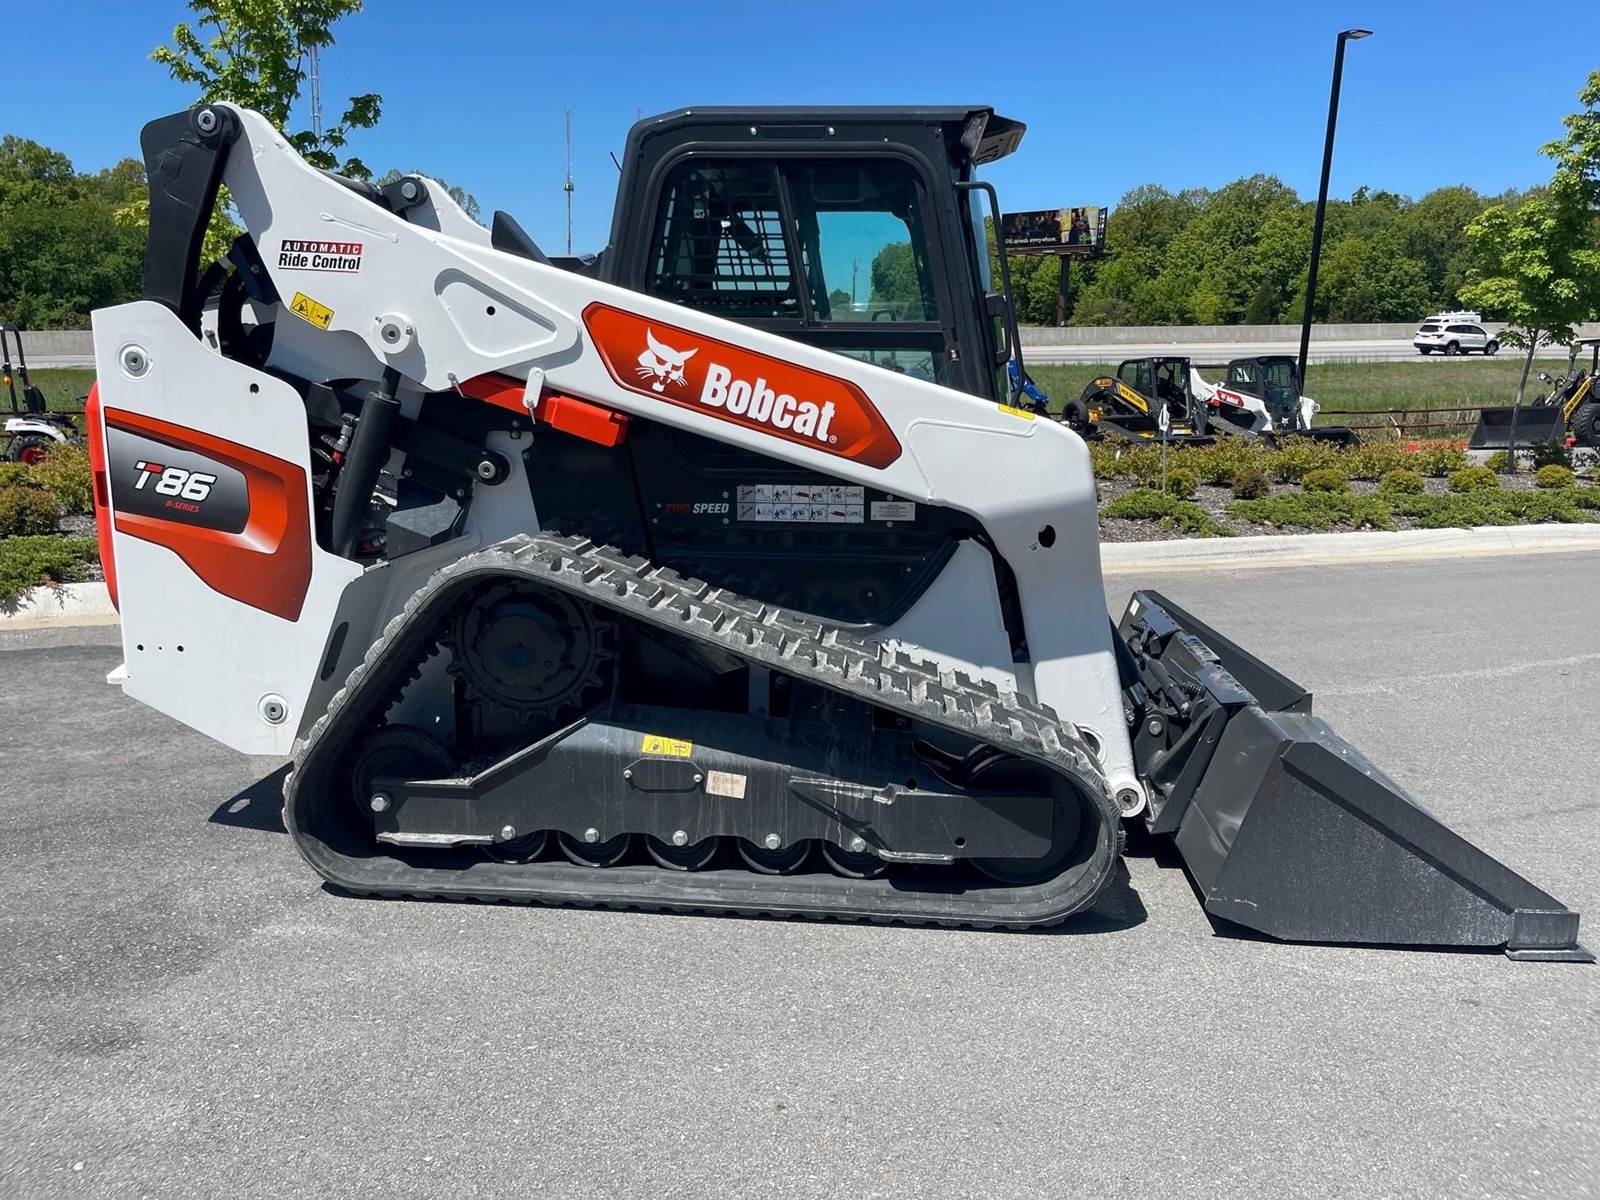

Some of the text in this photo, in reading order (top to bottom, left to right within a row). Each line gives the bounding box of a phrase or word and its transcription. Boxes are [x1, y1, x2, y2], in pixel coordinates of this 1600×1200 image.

[284, 241, 361, 254] AUTOMATIC
[278, 253, 361, 270] Ride Control
[700, 362, 836, 443] Bobcat
[135, 461, 217, 501] T86
[164, 499, 200, 513] R-SERIES
[692, 503, 730, 514] SPEED
